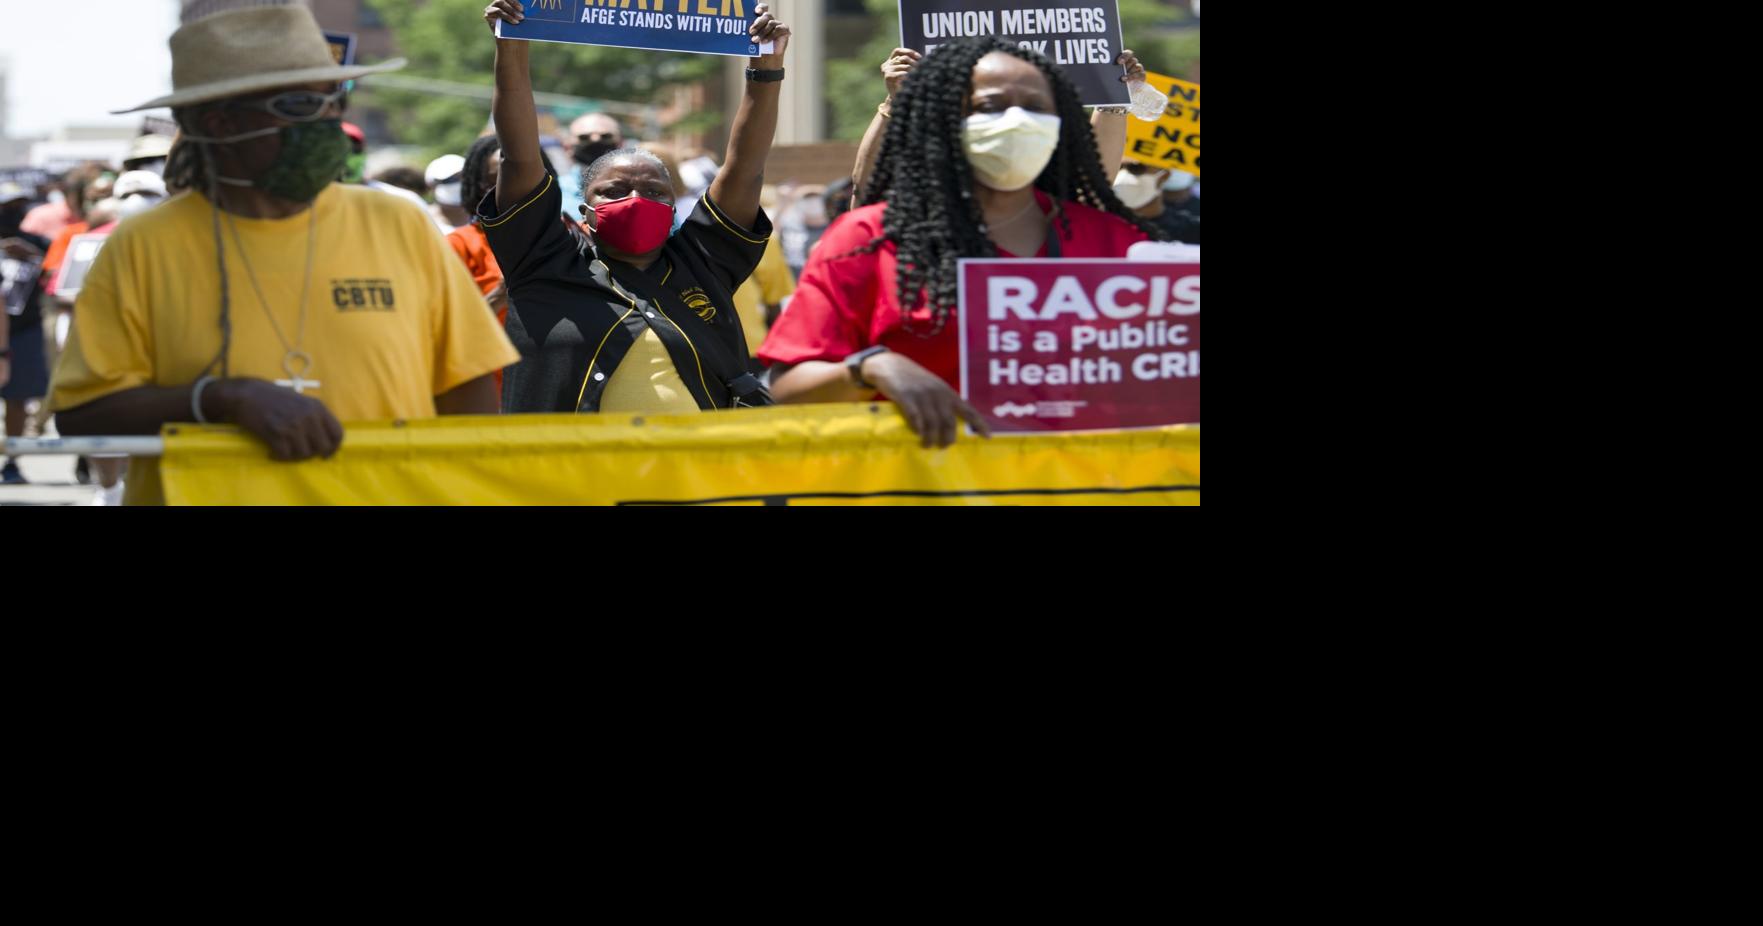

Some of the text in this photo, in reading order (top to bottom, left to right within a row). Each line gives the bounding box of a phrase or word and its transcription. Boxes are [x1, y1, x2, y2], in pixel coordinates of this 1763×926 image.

[581, 8, 615, 25] AFGE
[619, 11, 673, 30] STANDS
[677, 15, 711, 33] WITH
[716, 18, 747, 35] YOU!
[922, 7, 1106, 38] UNION MEMBERS
[1055, 38, 1111, 65] LIVES
[333, 287, 395, 307] CBTU
[987, 275, 1200, 320] RACIS
[988, 320, 1189, 352] is a Public
[988, 356, 1122, 385] Health
